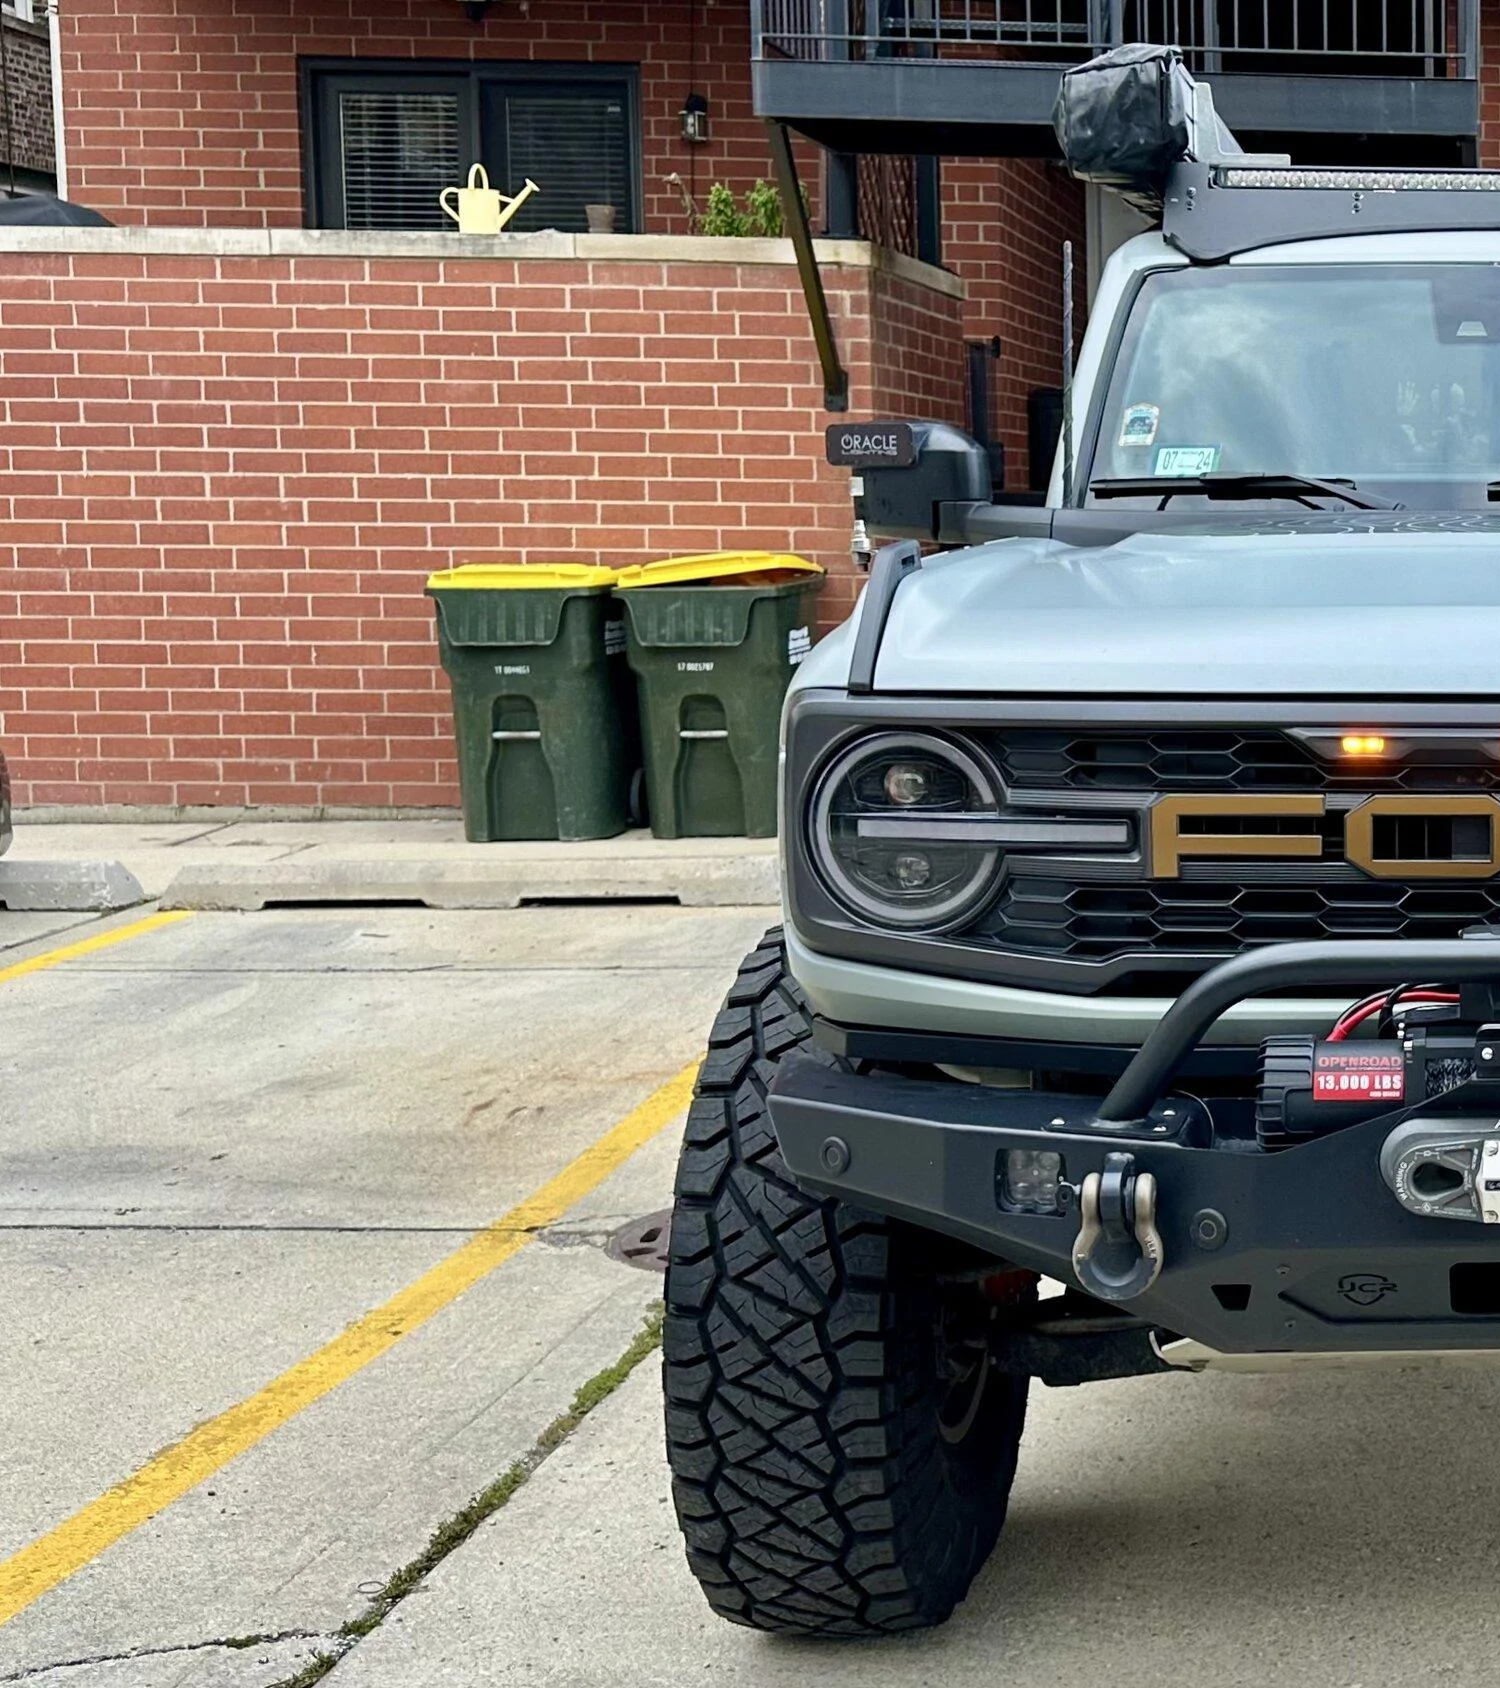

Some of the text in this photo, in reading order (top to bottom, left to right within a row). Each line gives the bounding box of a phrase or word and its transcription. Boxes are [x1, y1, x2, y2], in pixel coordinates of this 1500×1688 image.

[841, 434, 898, 450] ORACLE
[1162, 450, 1179, 470] 07
[1195, 450, 1211, 471] 24
[1318, 1056, 1402, 1067] OPENROAD
[1317, 1074, 1402, 1091] 13,000 LBS
